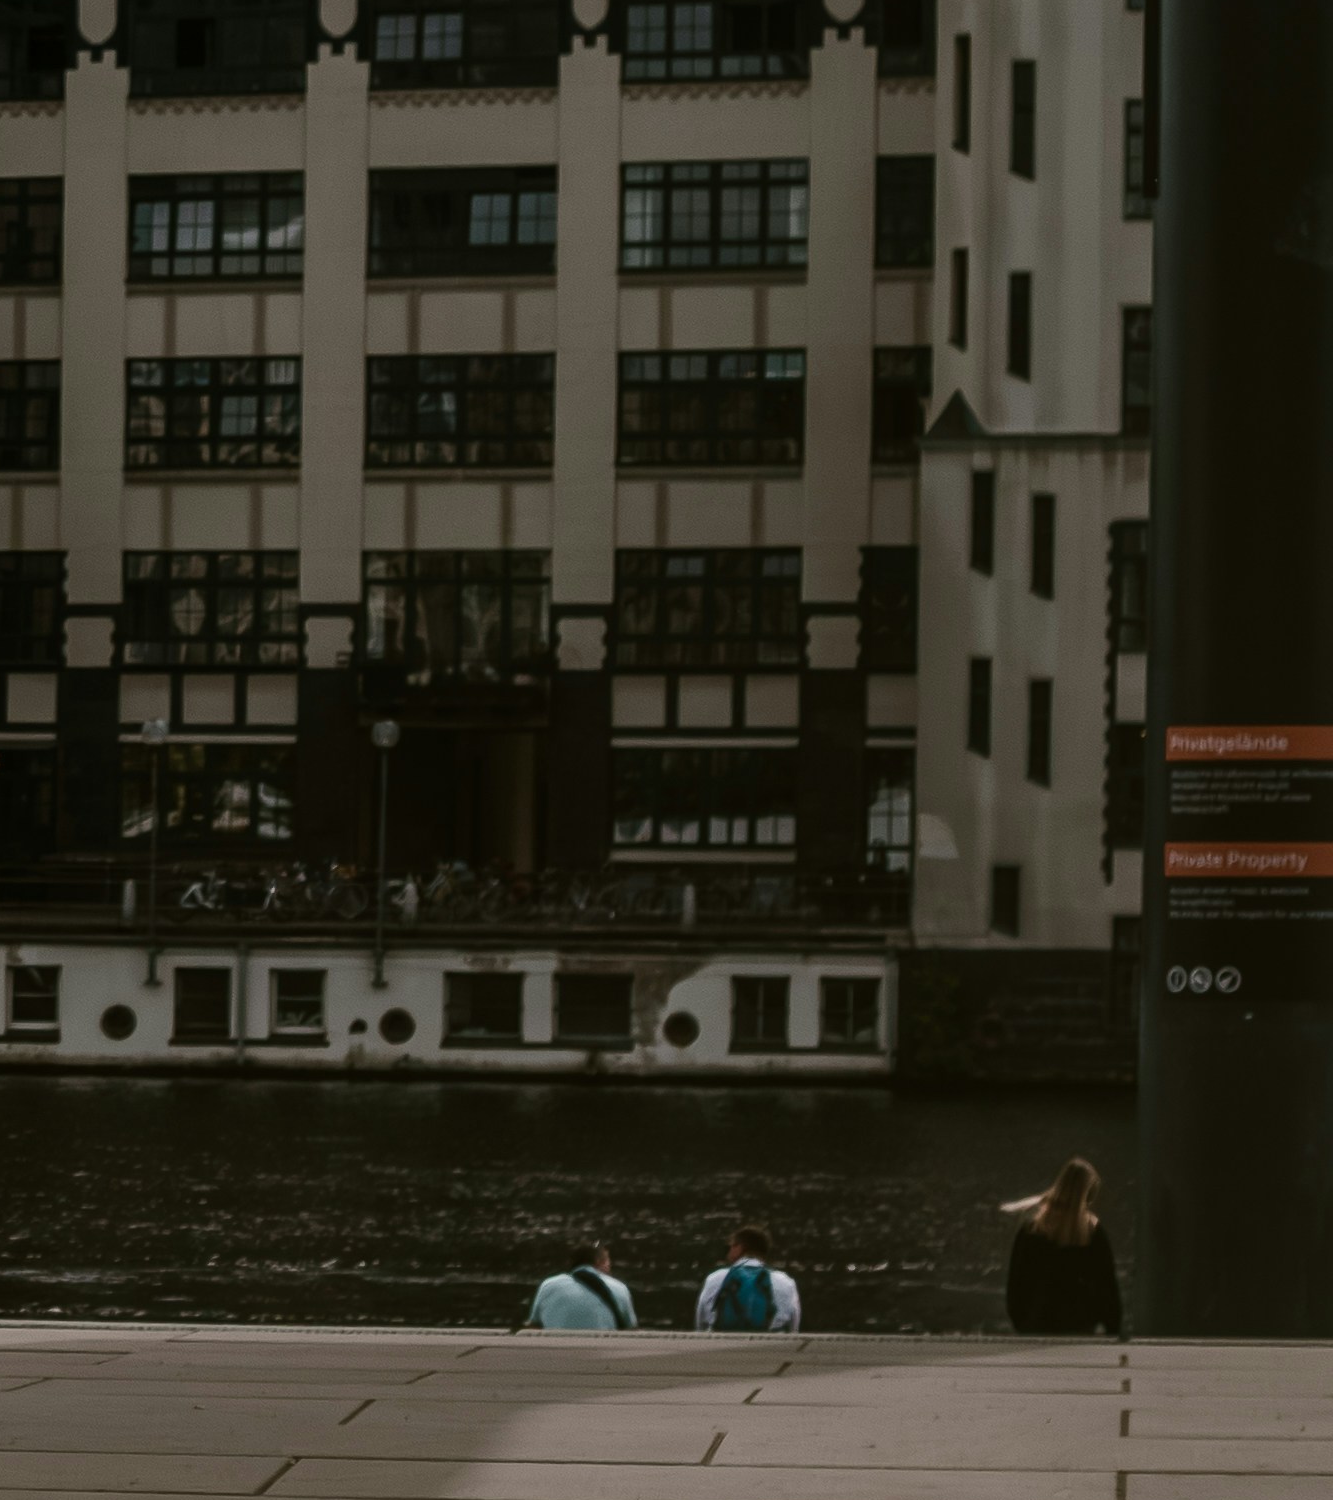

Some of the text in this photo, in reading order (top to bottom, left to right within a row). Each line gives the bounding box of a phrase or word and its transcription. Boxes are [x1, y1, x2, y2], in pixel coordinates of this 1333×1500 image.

[1171, 734, 1288, 756] Privatgelände
[1169, 850, 1308, 873] Private Property
